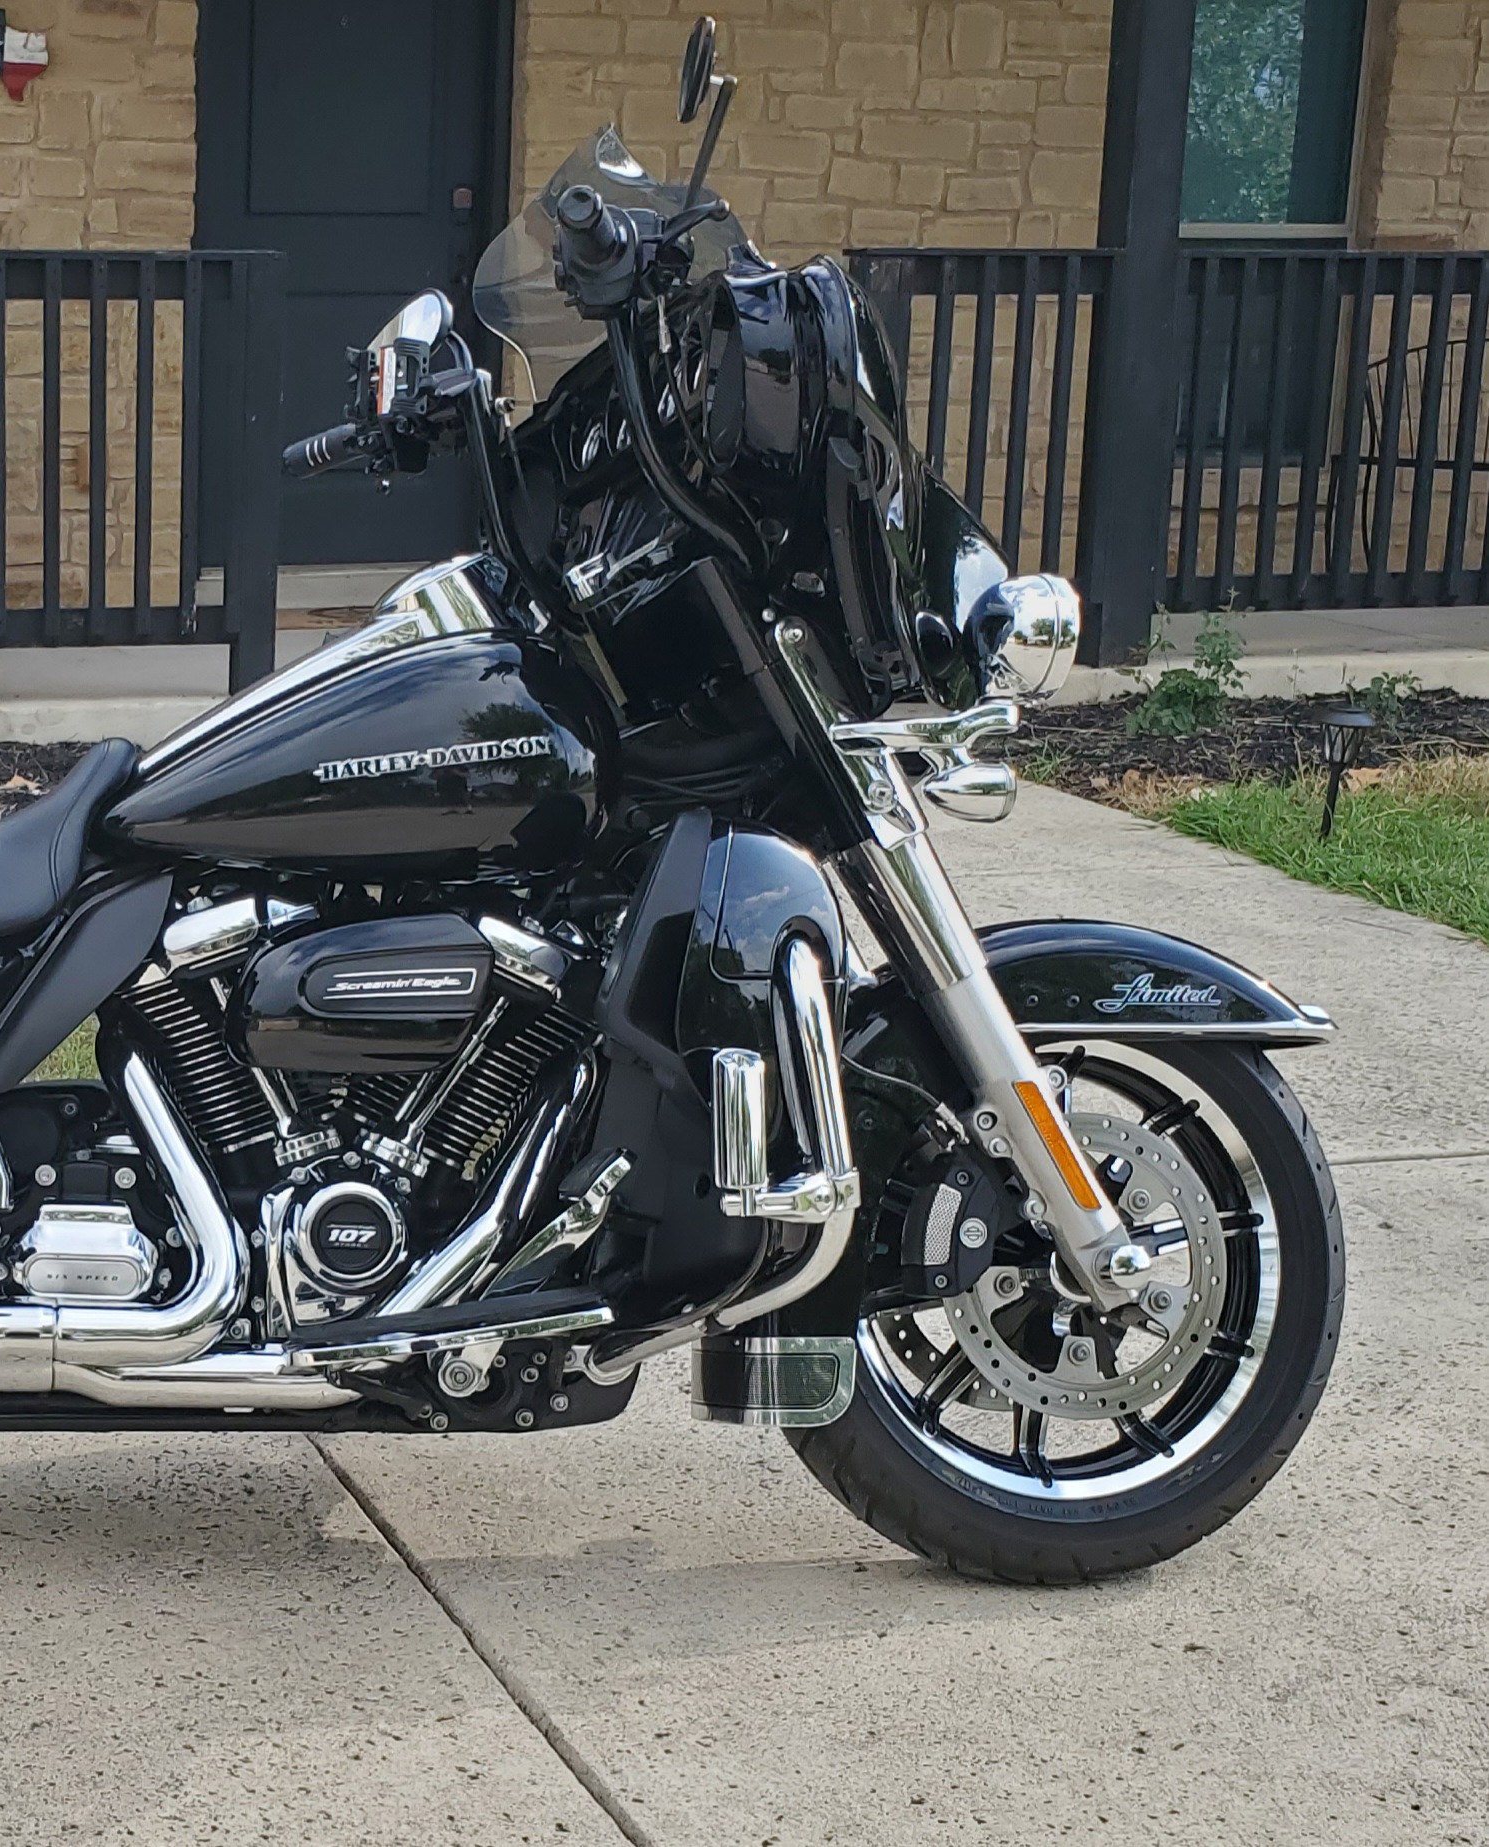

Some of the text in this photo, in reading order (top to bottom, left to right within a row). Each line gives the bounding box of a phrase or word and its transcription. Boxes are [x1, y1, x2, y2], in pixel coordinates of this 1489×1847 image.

[412, 976, 462, 989] Eagle
[1093, 973, 1221, 1013] Limited
[328, 1228, 377, 1243] 107
[77, 1274, 119, 1282] SPEED
